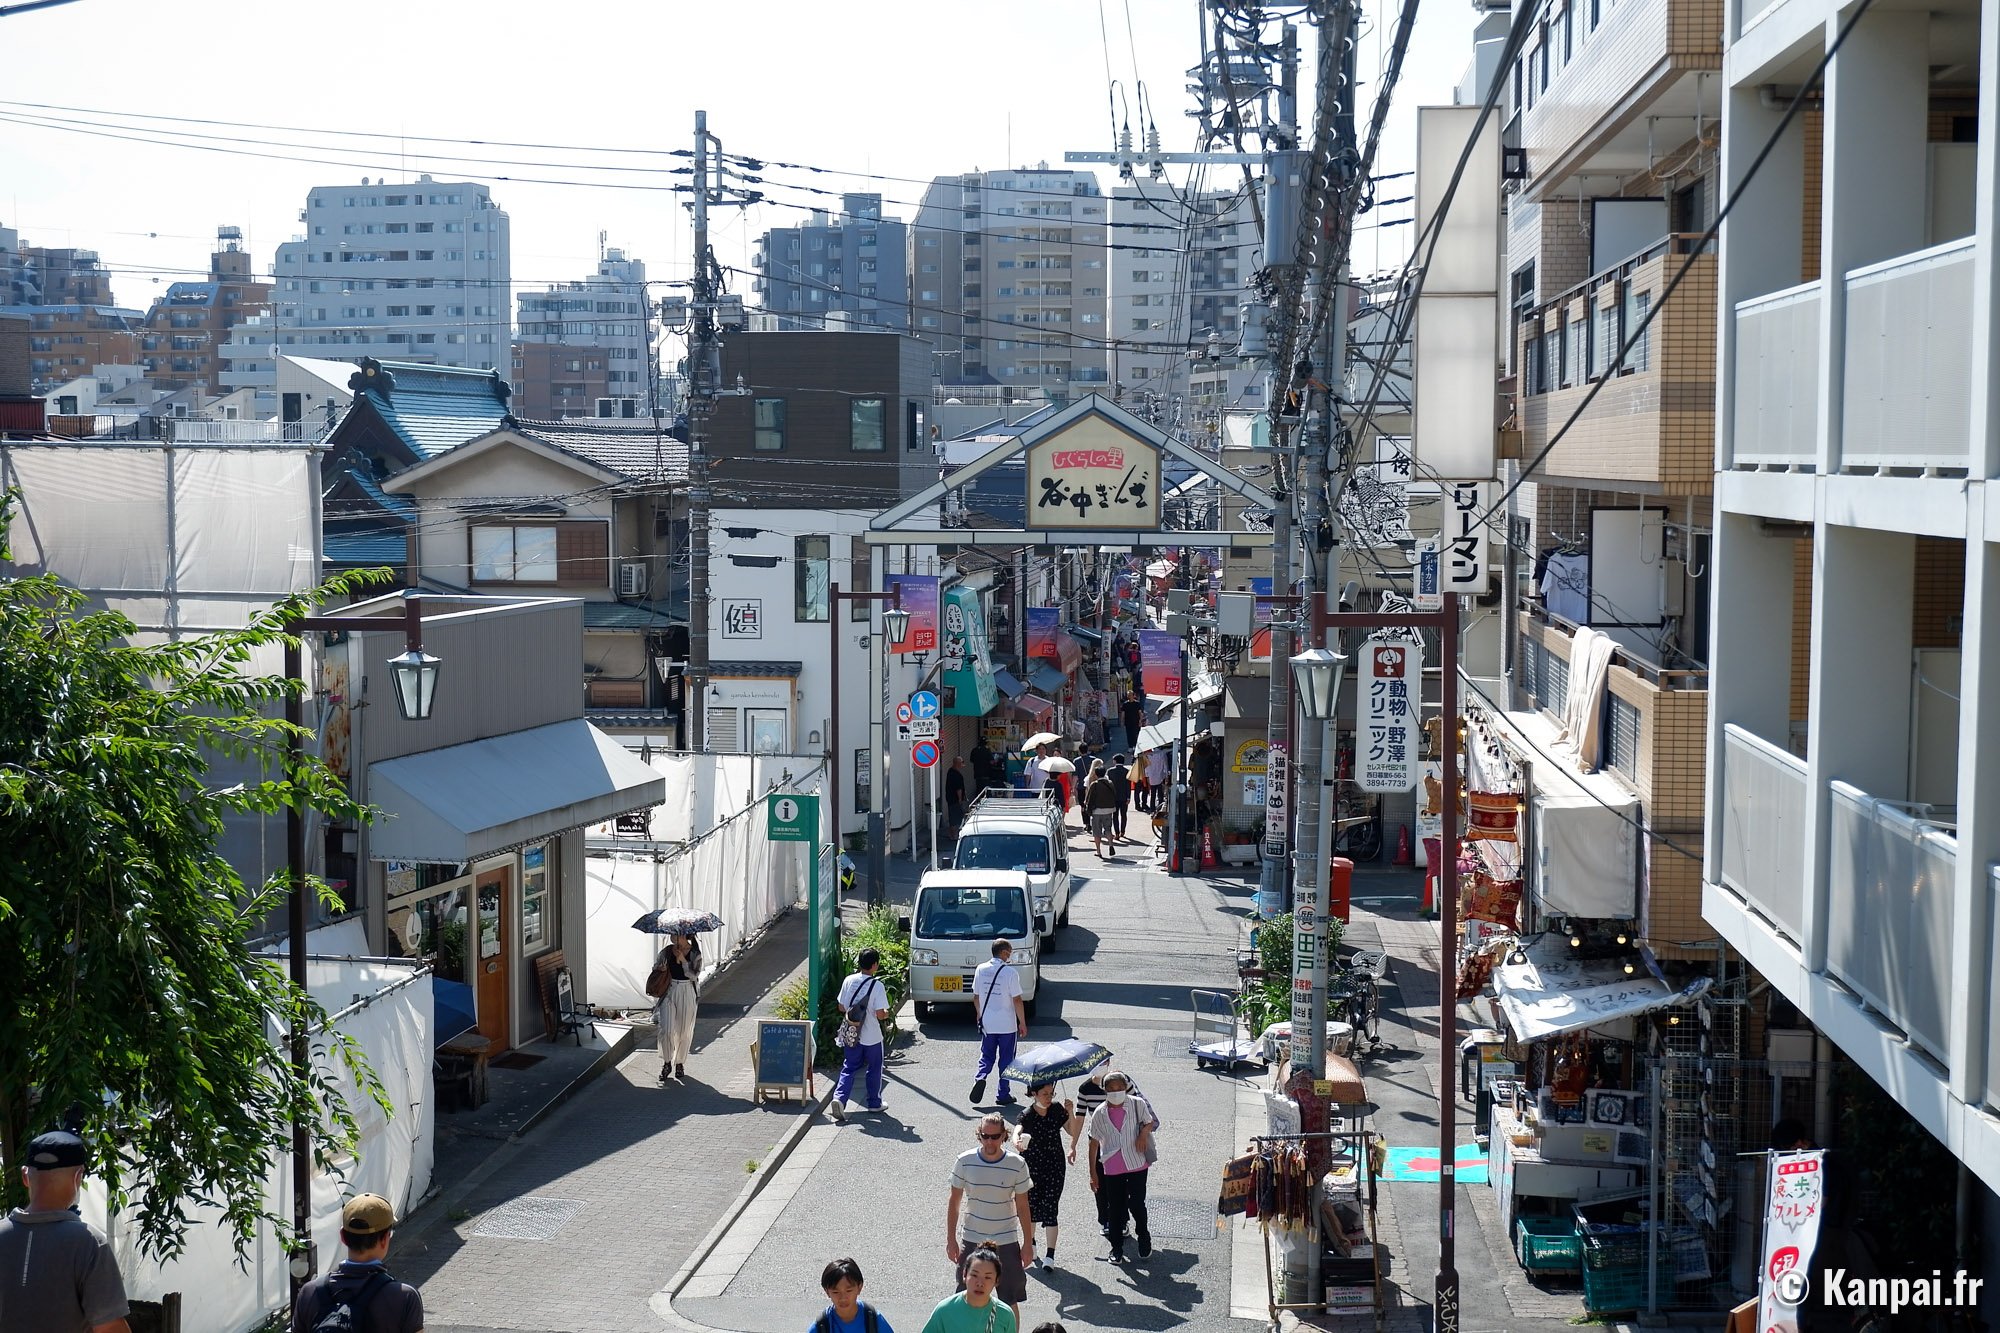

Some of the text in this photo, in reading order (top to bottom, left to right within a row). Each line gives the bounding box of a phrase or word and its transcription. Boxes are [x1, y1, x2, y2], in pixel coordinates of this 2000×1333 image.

[1053, 447, 1123, 469] ひぐらしの里
[1038, 465, 1149, 518] 谷中ぎんざ
[1369, 680, 1387, 761] クリニック
[1387, 680, 1407, 762] 動物・野澤
[1274, 757, 1286, 792] 猫雑貨
[1367, 779, 1407, 787] 3894-7739
[1204, 832, 1212, 858] 立入禁止
